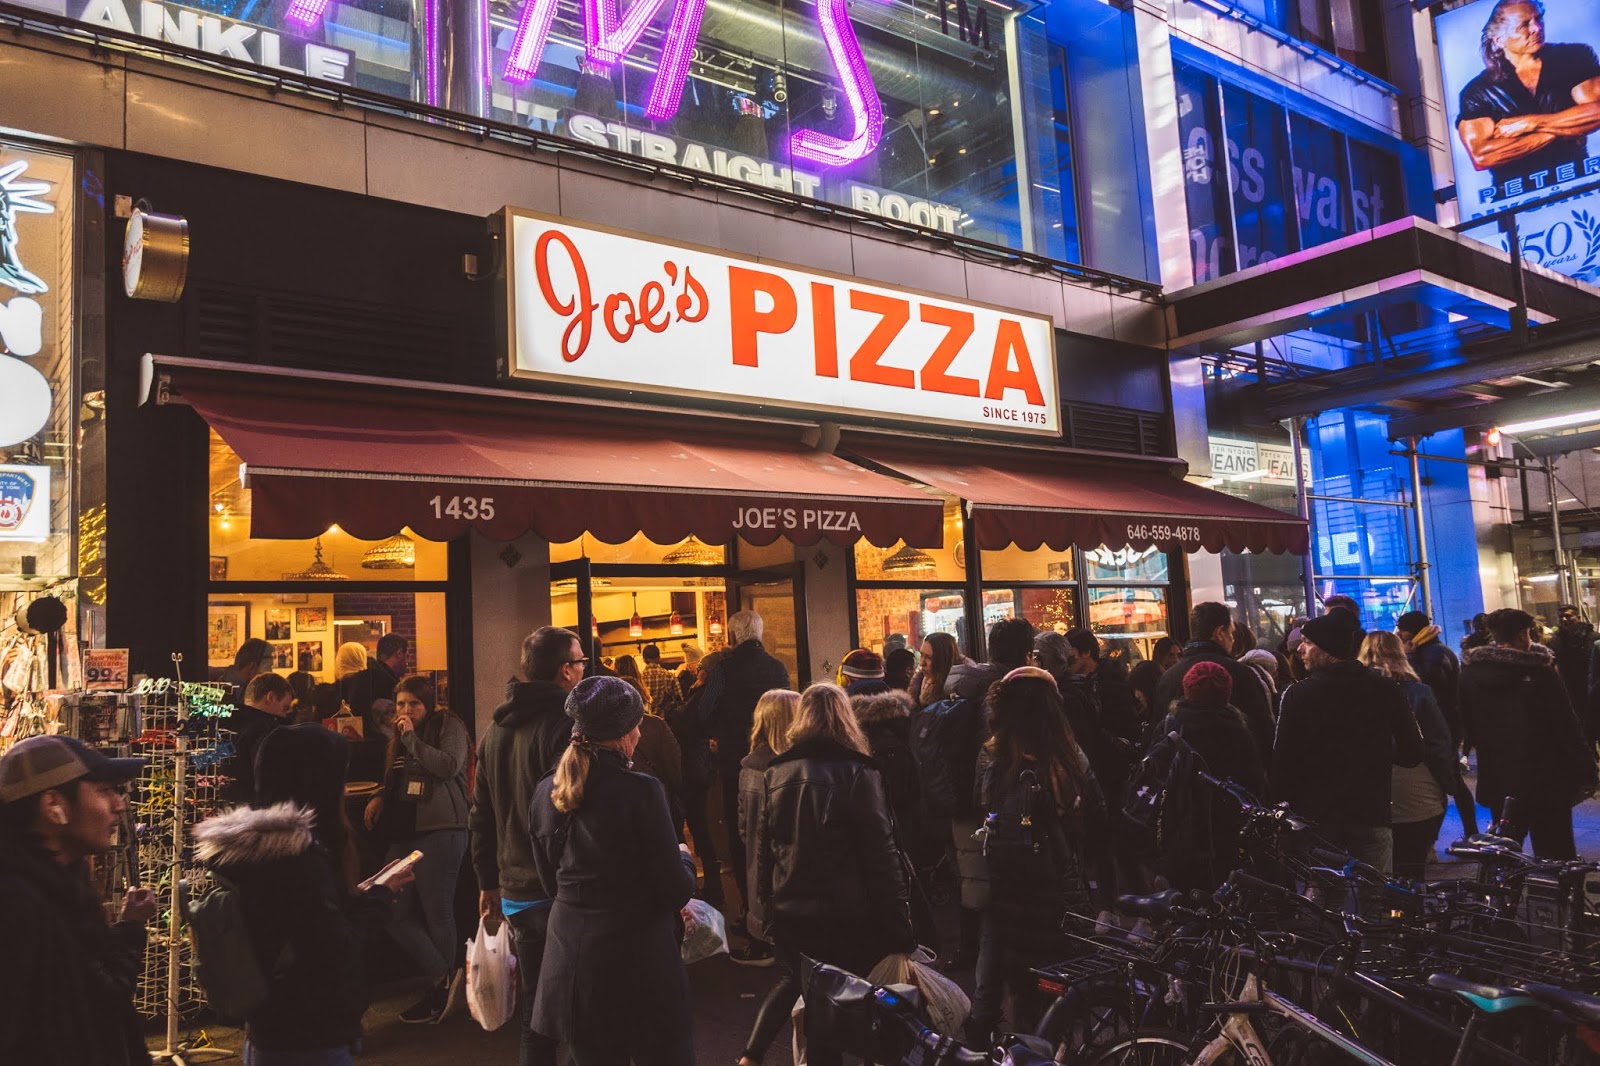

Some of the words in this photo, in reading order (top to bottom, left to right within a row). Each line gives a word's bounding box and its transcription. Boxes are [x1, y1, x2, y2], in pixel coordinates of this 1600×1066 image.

[74, 0, 353, 85] ANKLE
[565, 113, 821, 200] STRAIGHT
[850, 183, 963, 235] BOOT
[1477, 156, 1600, 205] PETER
[1521, 221, 1573, 266] 50
[1543, 252, 1579, 268] years
[534, 229, 710, 363] Joe's
[728, 265, 1046, 407] PIZZA
[983, 406, 1019, 421] SINCE
[1022, 411, 1047, 425] 1975
[0, 472, 31, 488] EPARTMENT
[429, 495, 496, 521] 1435
[732, 506, 797, 530] JOE'S
[803, 508, 862, 533] PIZZA
[1126, 524, 1201, 542] 646-559-4878
